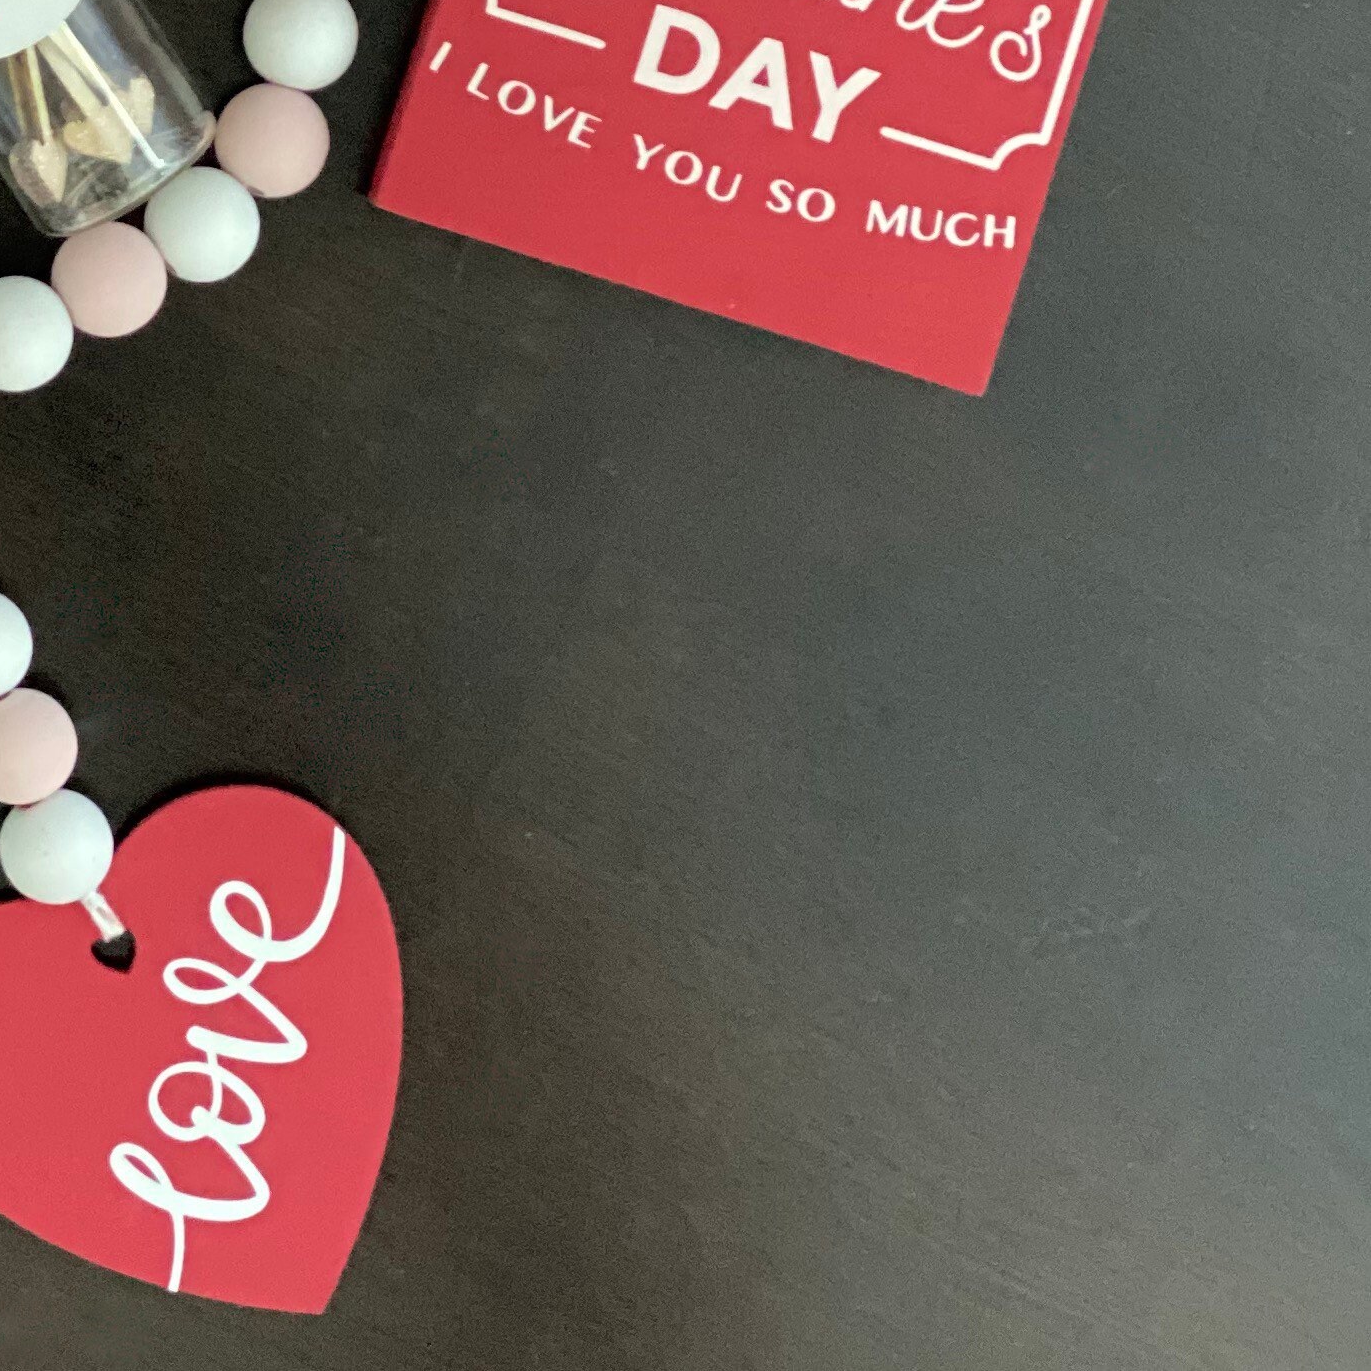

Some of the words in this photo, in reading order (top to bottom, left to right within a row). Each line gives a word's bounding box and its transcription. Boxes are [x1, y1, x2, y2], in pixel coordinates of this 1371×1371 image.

[429, 41, 452, 75] I
[466, 62, 602, 149] LOVE
[632, 134, 743, 204] YOU
[766, 178, 837, 224] SO
[865, 199, 1017, 250] MUCH
[632, 3, 881, 144] DAY
[109, 825, 346, 1293] love
